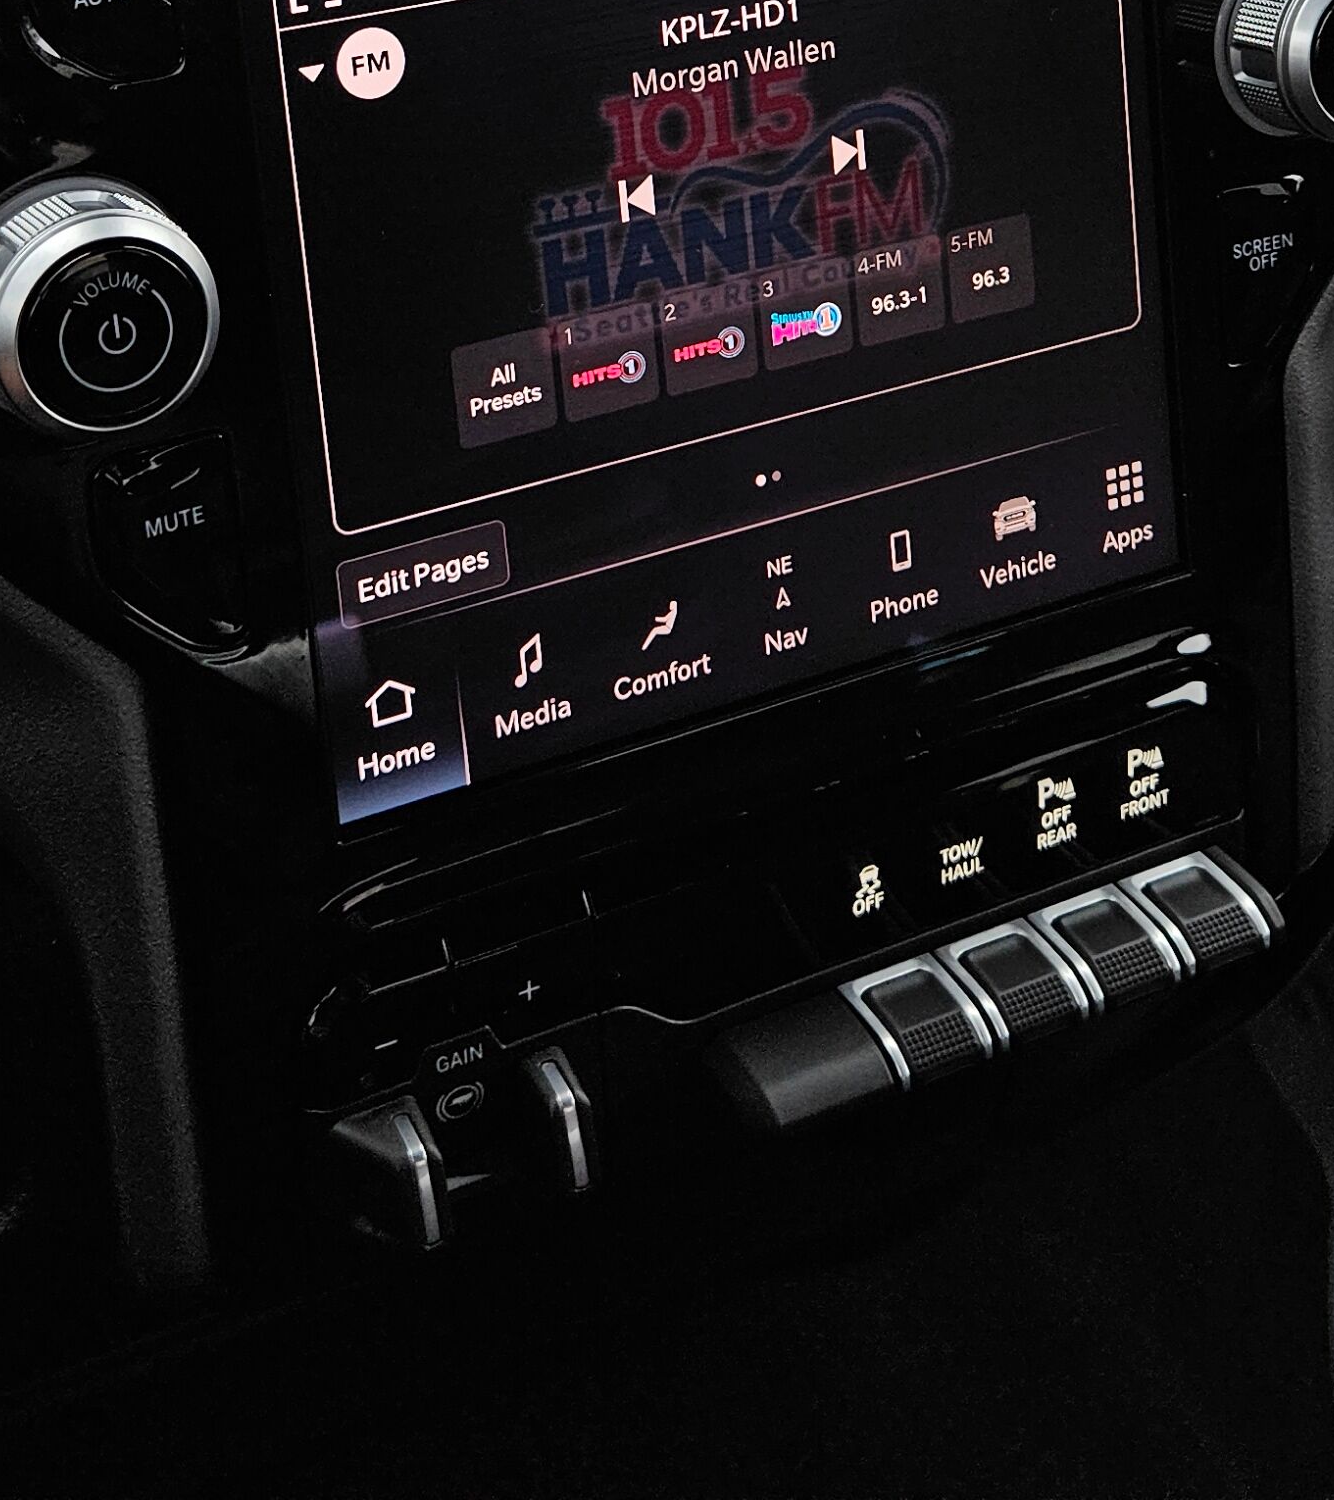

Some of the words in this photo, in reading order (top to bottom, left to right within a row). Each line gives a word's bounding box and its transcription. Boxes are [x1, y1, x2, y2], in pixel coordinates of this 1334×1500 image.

[351, 50, 391, 77] FM
[632, 57, 740, 100] Morgan
[743, 38, 837, 75] Wallen
[950, 227, 995, 253] 5-FM
[1232, 233, 1294, 260] SCREEN
[857, 251, 903, 277] 4-FM
[1249, 252, 1279, 272] OFF
[73, 271, 150, 309] VOLUME
[762, 281, 774, 299] 3
[971, 266, 1012, 293] 96.3
[665, 303, 677, 322] 2
[870, 286, 928, 318] 96.3-1
[564, 327, 574, 346] 1
[489, 361, 517, 387] All
[468, 381, 544, 419] Presets
[145, 504, 206, 539] MUTE
[1102, 523, 1154, 555] Apps
[357, 571, 410, 605] Edit
[413, 549, 491, 587] Pages
[766, 554, 793, 579] NE
[979, 550, 1058, 590] Vehicle
[870, 587, 939, 625] Phone
[763, 627, 810, 656] Nav
[612, 652, 713, 702] Comfort
[494, 697, 573, 739] Media
[356, 740, 437, 783] Home
[1129, 773, 1160, 798] OFF
[1041, 804, 1071, 830] OFF
[1120, 788, 1170, 821] FRONT
[939, 835, 984, 866] TOW/
[1036, 823, 1078, 851] REAR
[940, 856, 985, 885] HAUL
[851, 891, 885, 919] OFF
[435, 1042, 484, 1074] GAIN
